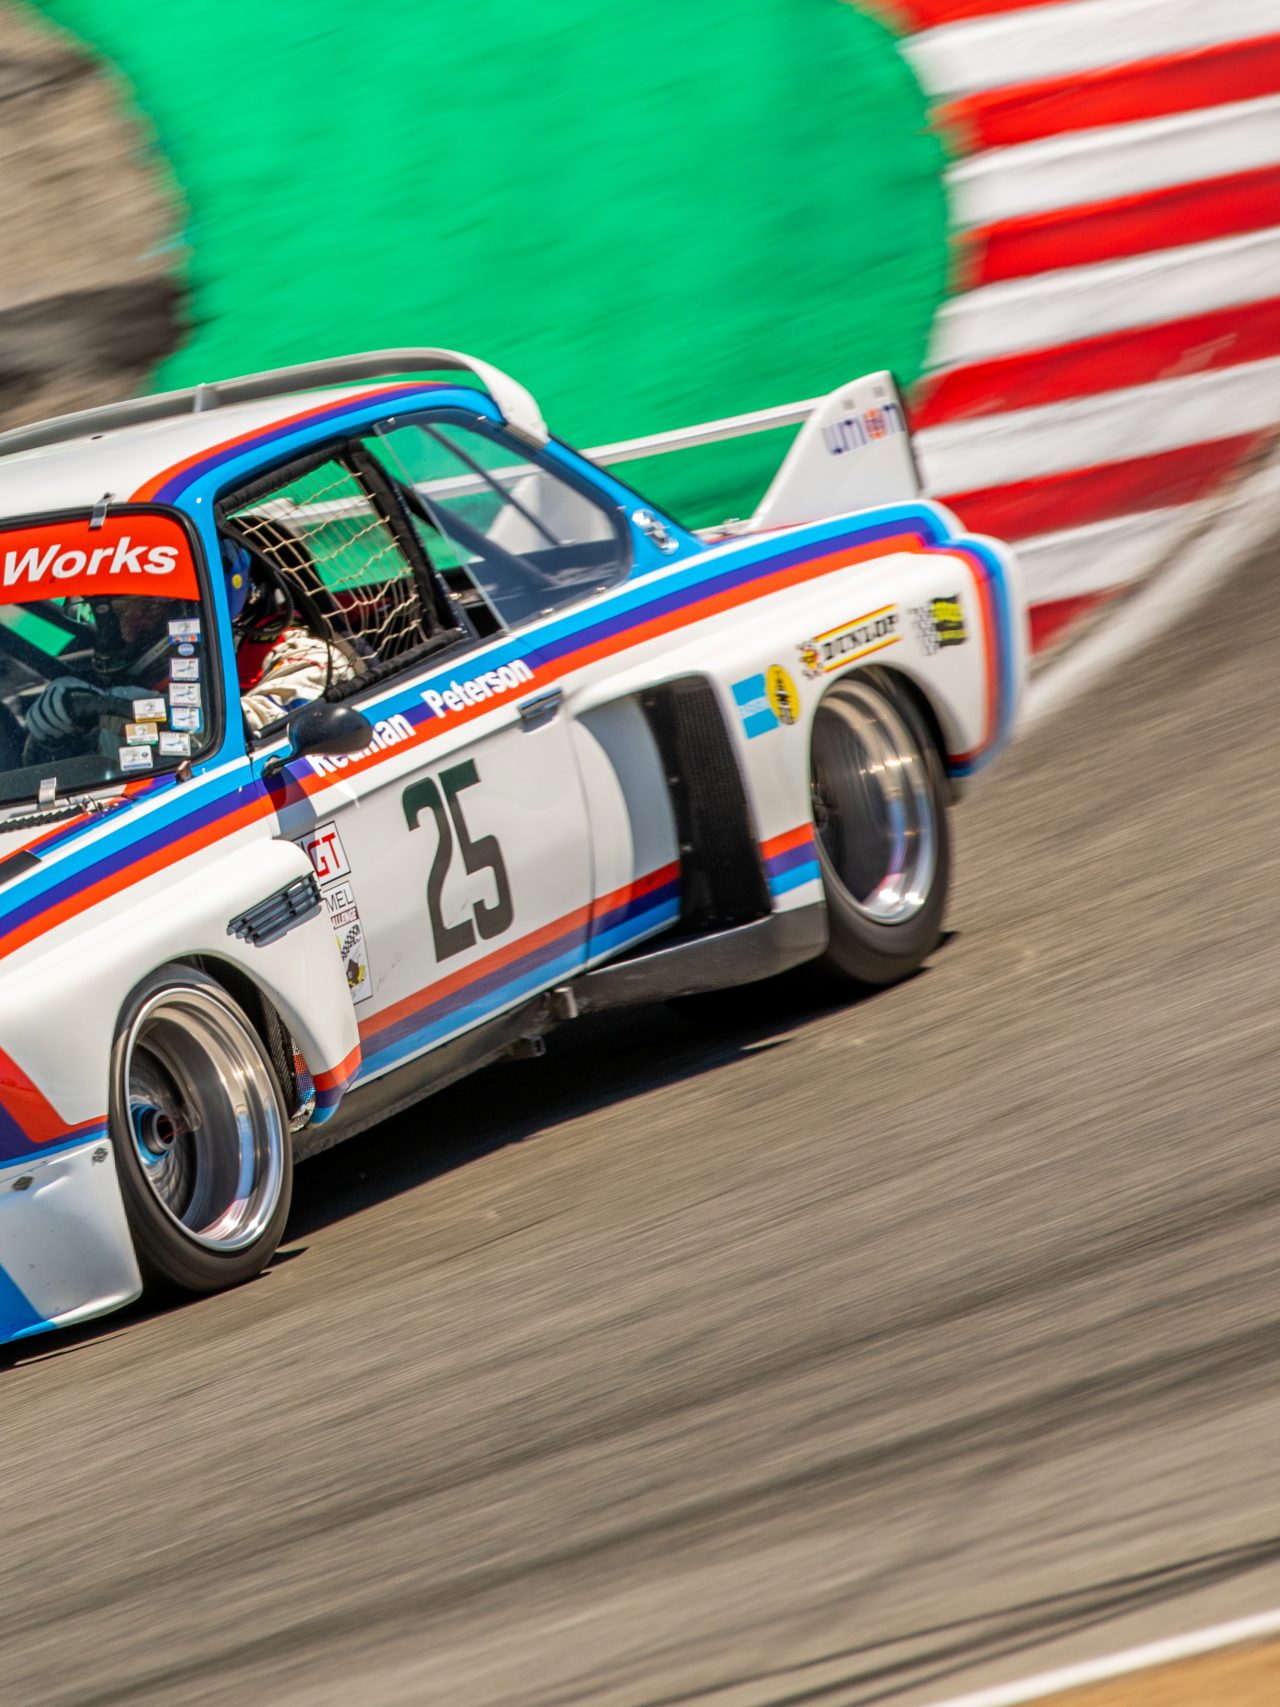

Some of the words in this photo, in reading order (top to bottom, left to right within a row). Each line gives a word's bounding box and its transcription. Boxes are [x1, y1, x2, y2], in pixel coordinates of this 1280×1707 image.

[3, 536, 179, 587] Works
[420, 658, 535, 719] Peterson
[307, 832, 340, 878] GT
[402, 758, 515, 964] 25
